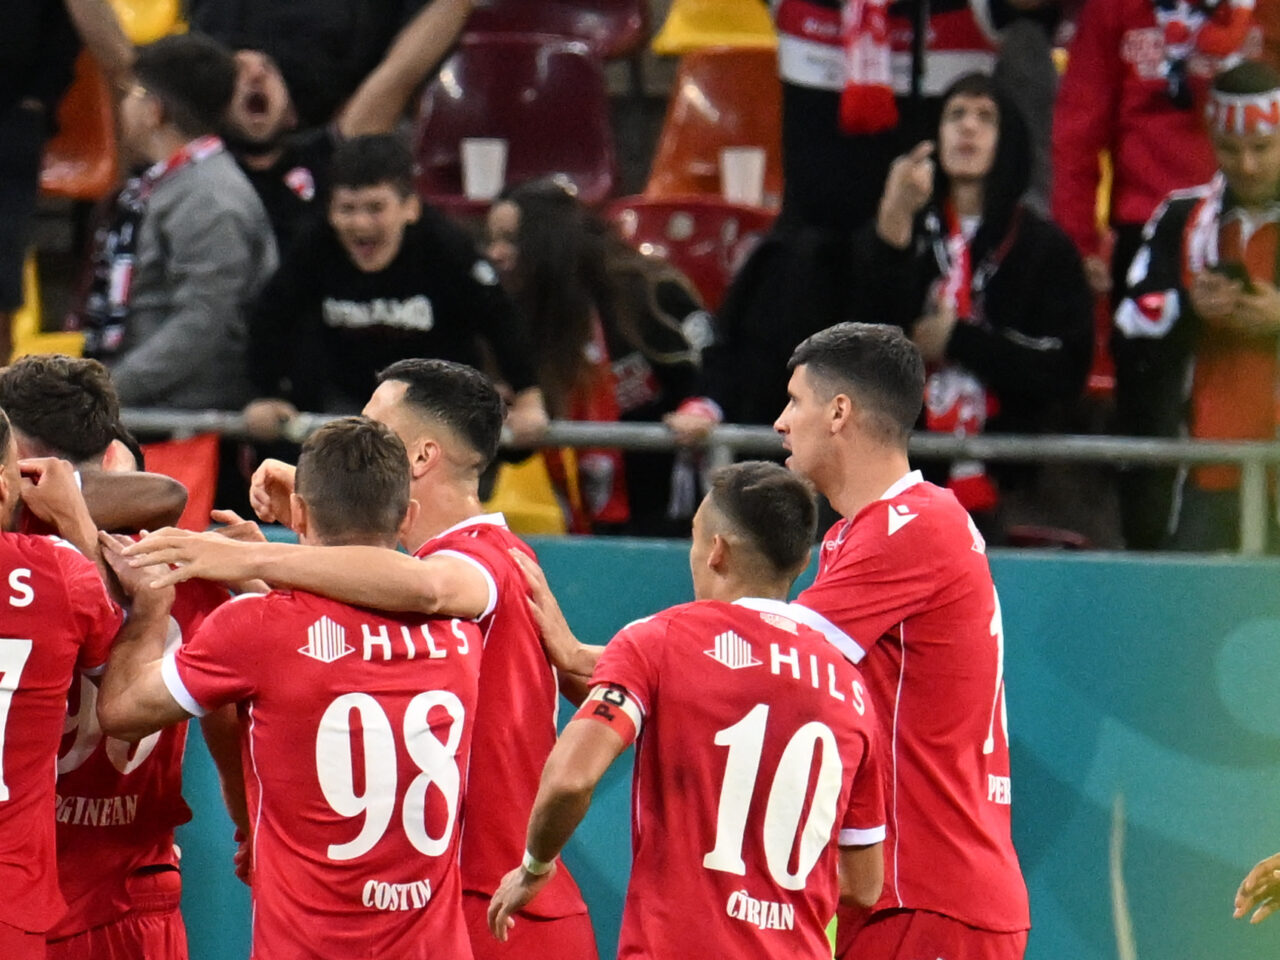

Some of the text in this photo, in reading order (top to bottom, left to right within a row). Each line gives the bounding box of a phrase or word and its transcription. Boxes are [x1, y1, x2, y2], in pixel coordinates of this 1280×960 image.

[361, 618, 470, 661] HILS
[769, 642, 865, 715] HILS
[316, 689, 466, 861] 98
[703, 703, 844, 891] 10
[362, 879, 432, 912] COSTIN
[726, 889, 796, 932] CÎRJAN
